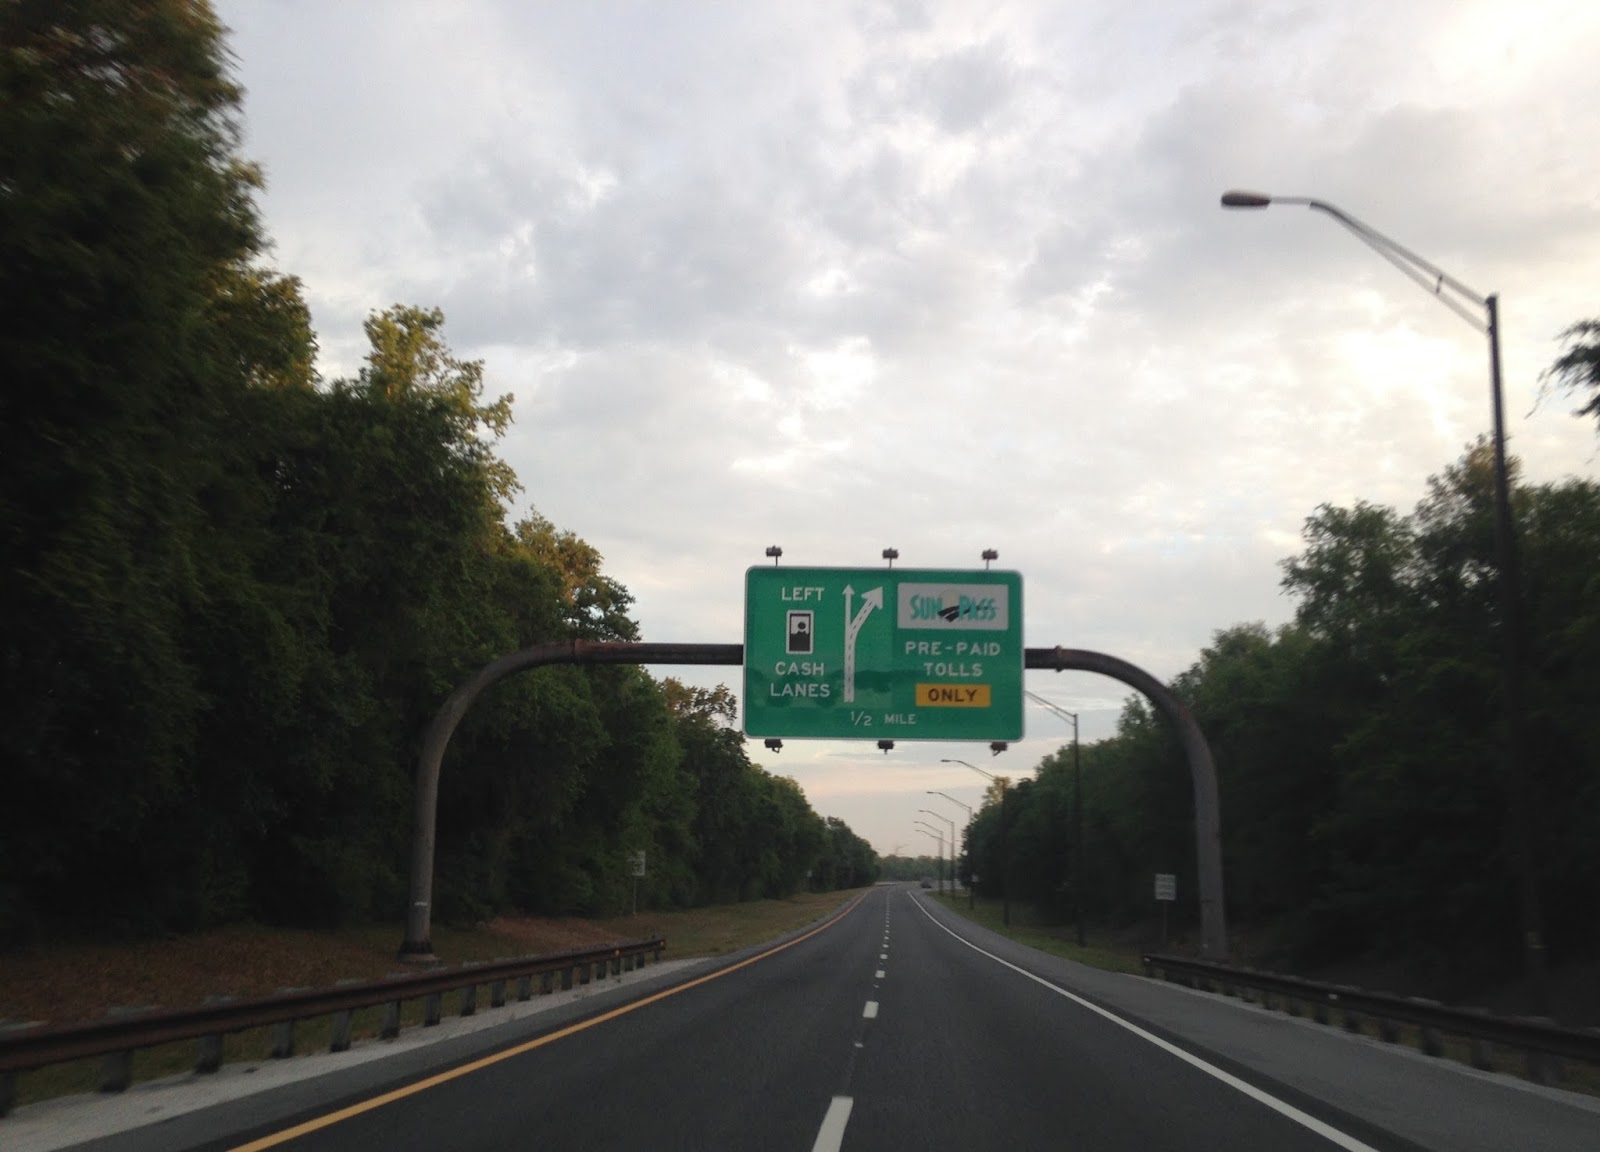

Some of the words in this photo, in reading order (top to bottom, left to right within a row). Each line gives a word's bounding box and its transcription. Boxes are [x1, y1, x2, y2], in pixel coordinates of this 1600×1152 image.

[781, 587, 825, 601] LEFT
[910, 594, 943, 620] SUN
[905, 641, 1001, 656] PRE-PAID
[775, 661, 825, 676] CASH
[923, 662, 983, 677] TOLLS
[770, 683, 831, 698] LANES
[927, 688, 978, 702] ONLY
[850, 711, 872, 727] 1/2
[884, 714, 917, 725] MILE
